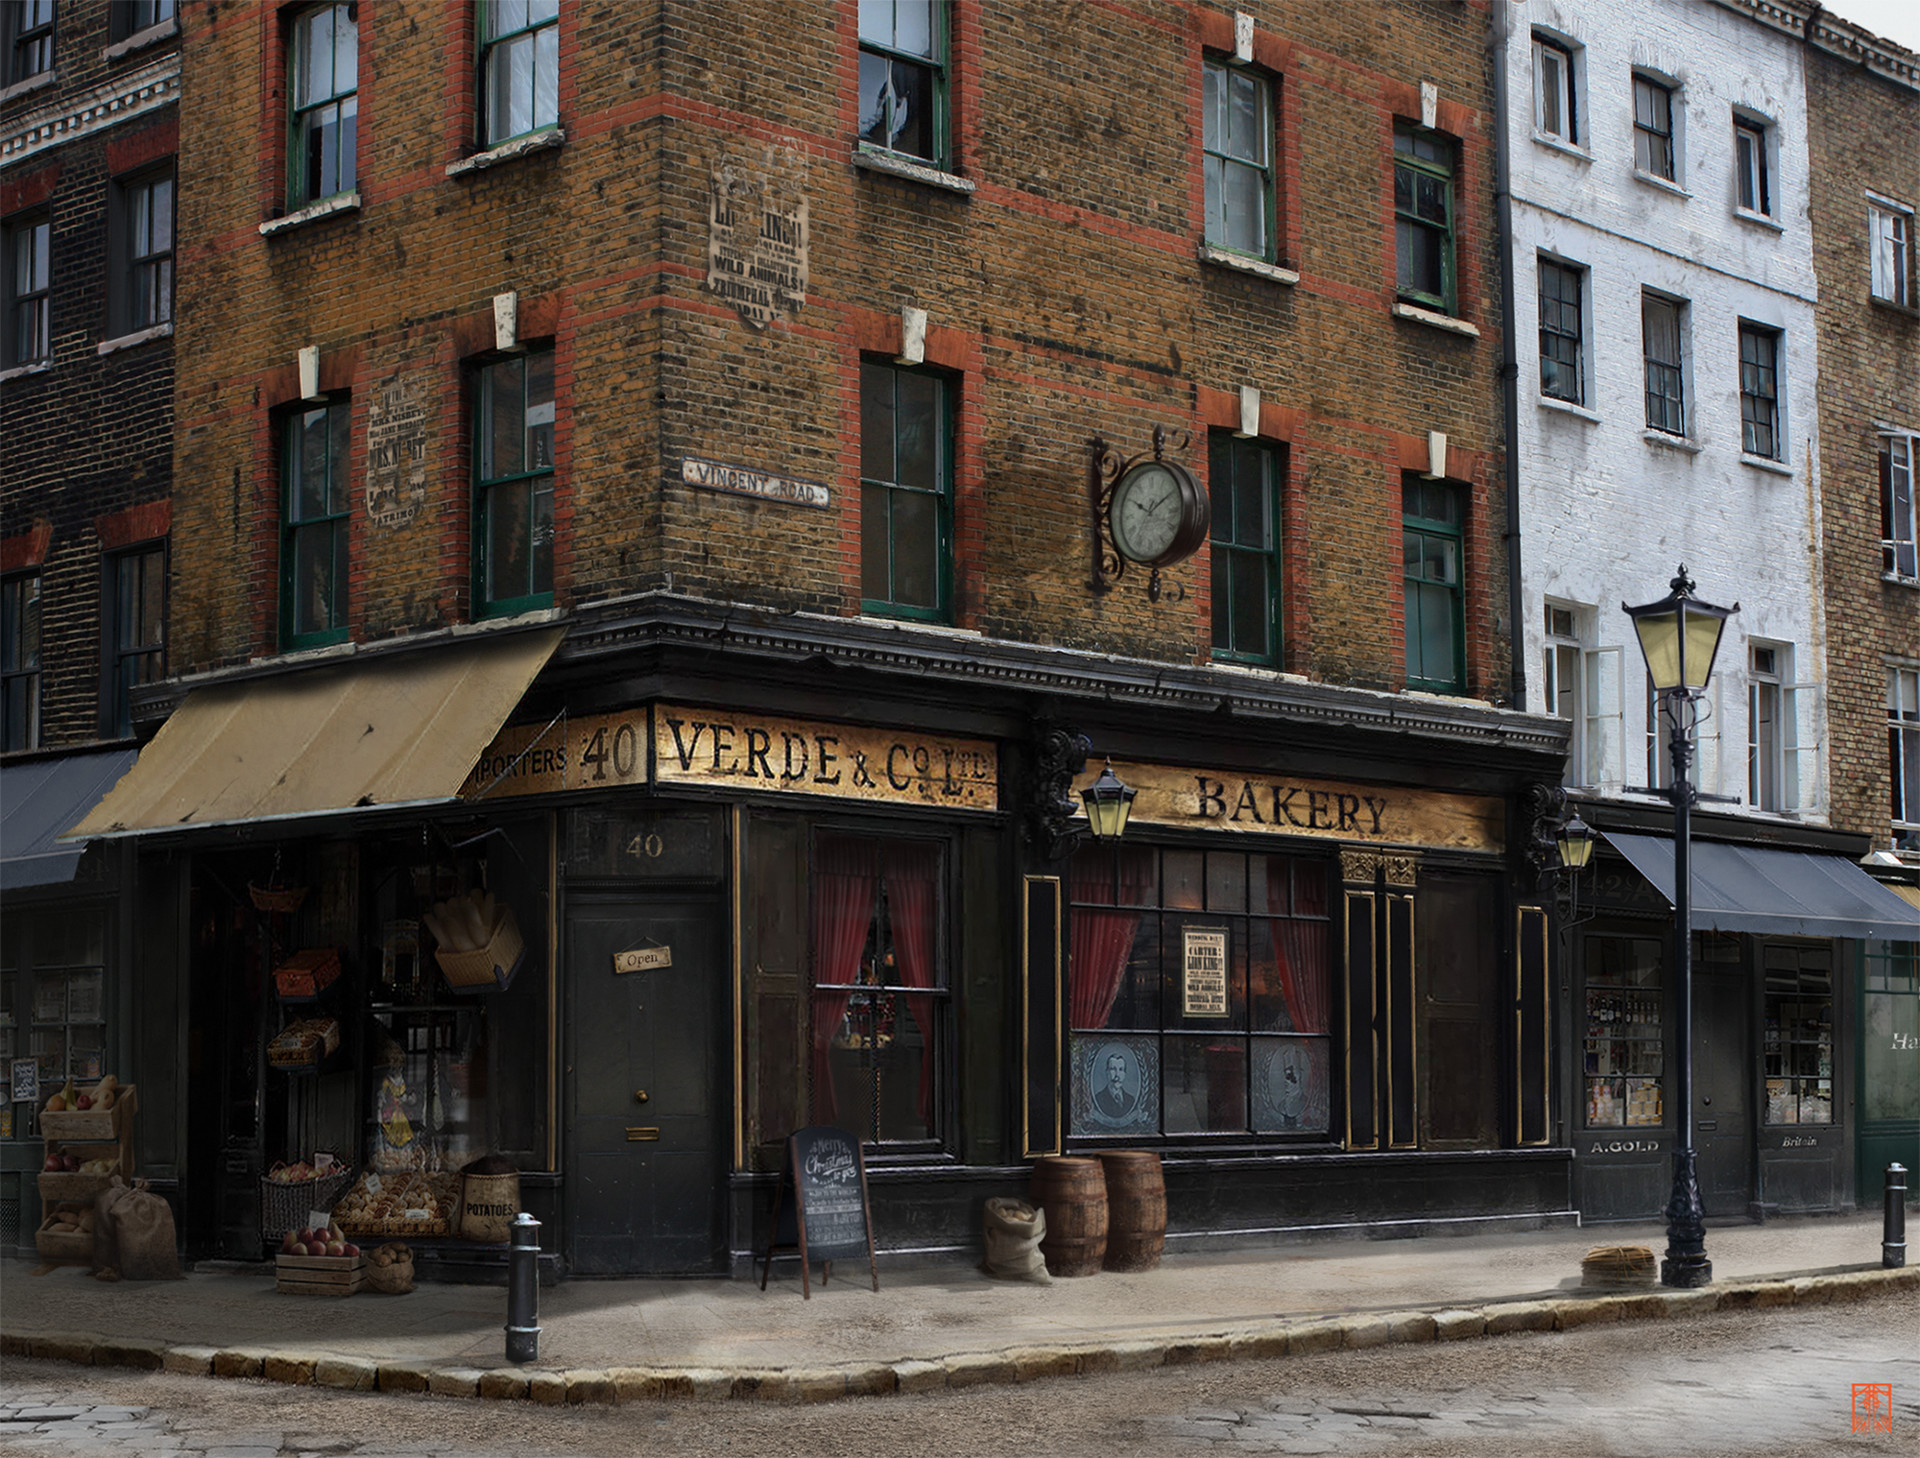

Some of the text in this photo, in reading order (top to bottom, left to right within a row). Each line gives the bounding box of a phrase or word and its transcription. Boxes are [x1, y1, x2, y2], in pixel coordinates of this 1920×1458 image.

[714, 254, 744, 275] WILD
[749, 265, 804, 293] ANIMALS!
[696, 464, 815, 502] VINCENT ROAD
[582, 723, 637, 781] 40
[666, 718, 841, 786] VERDE
[850, 750, 876, 789] &
[1194, 775, 1388, 835] BAKERY
[626, 834, 663, 858] 40
[627, 952, 659, 968] Open
[1591, 1140, 1660, 1153] A.GOLD
[466, 1203, 513, 1217] POTATOES
